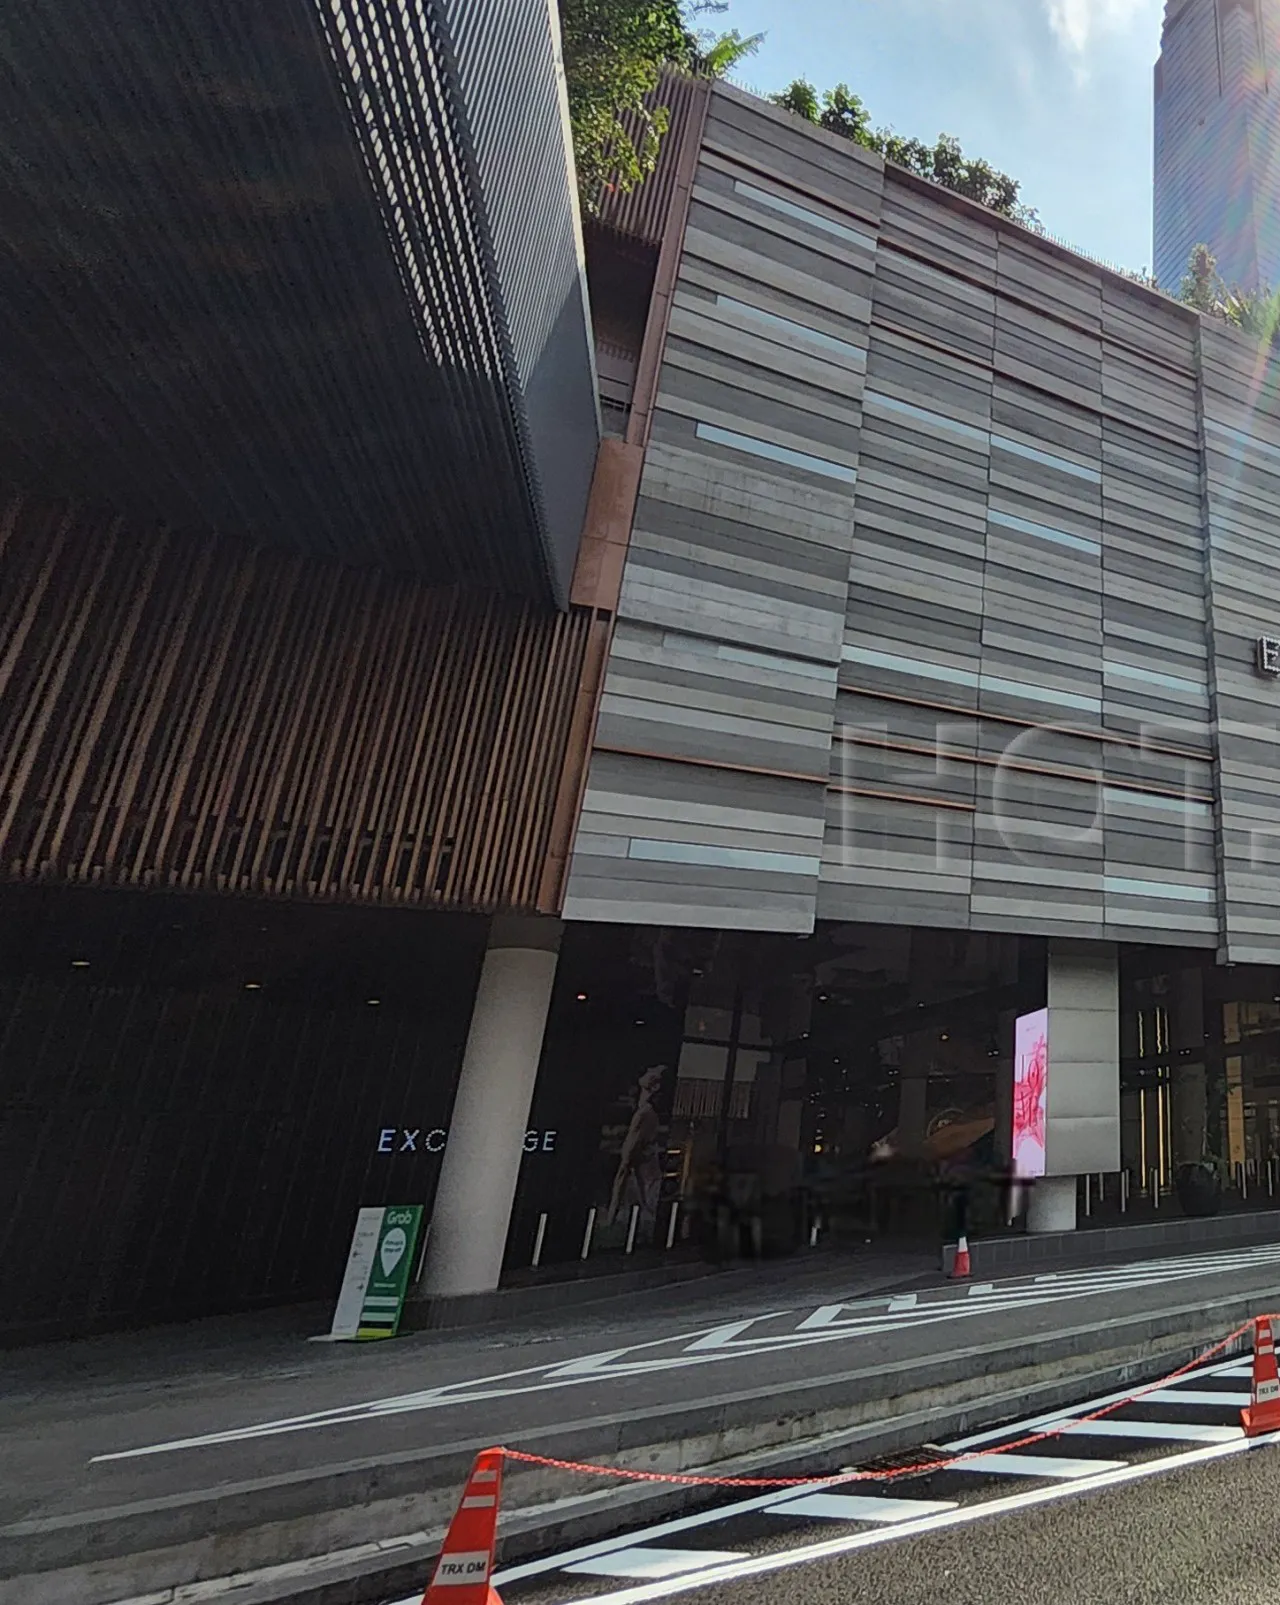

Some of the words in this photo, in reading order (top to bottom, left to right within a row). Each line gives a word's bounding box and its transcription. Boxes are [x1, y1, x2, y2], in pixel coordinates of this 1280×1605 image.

[387, 1209, 412, 1224] Grab
[442, 1563, 464, 1575] TRX
[467, 1561, 486, 1572] DM
